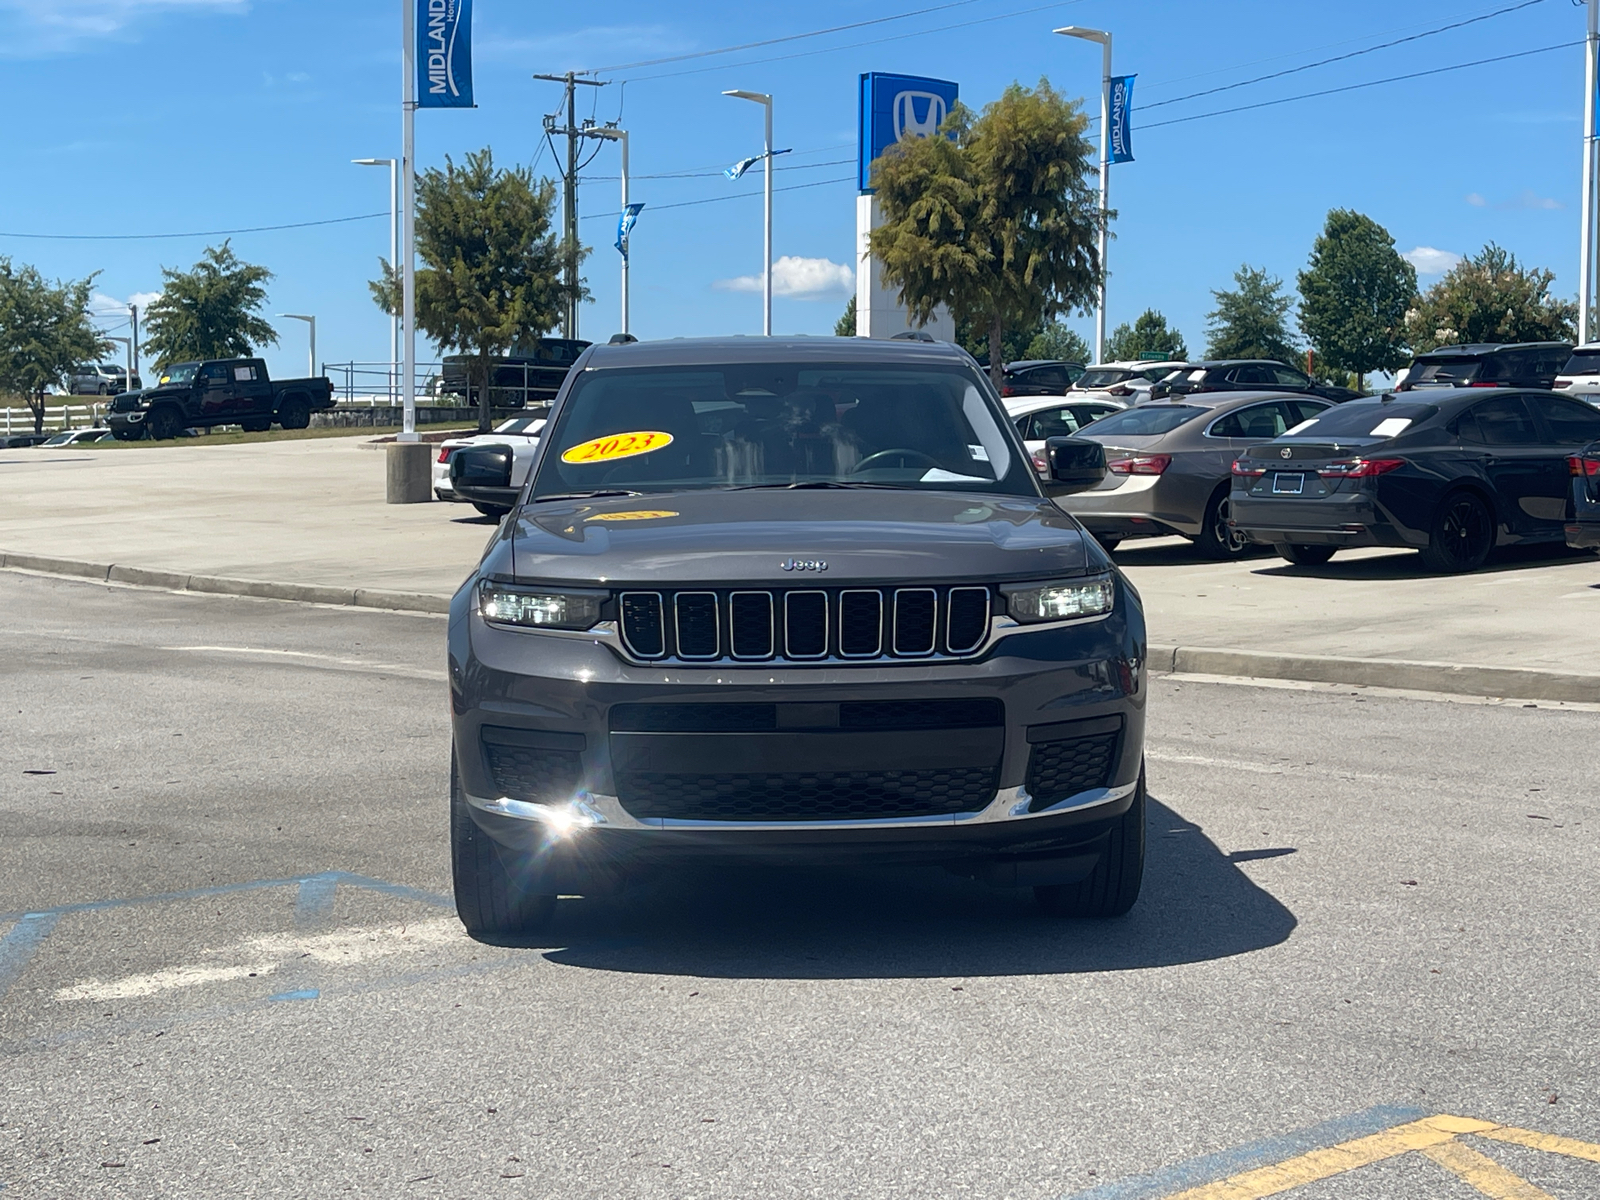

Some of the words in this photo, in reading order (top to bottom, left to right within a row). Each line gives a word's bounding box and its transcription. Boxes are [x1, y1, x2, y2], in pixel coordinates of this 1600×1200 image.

[1112, 82, 1124, 155] MIDLANDS
[580, 434, 655, 460] 2023
[780, 557, 829, 573] Jeep
